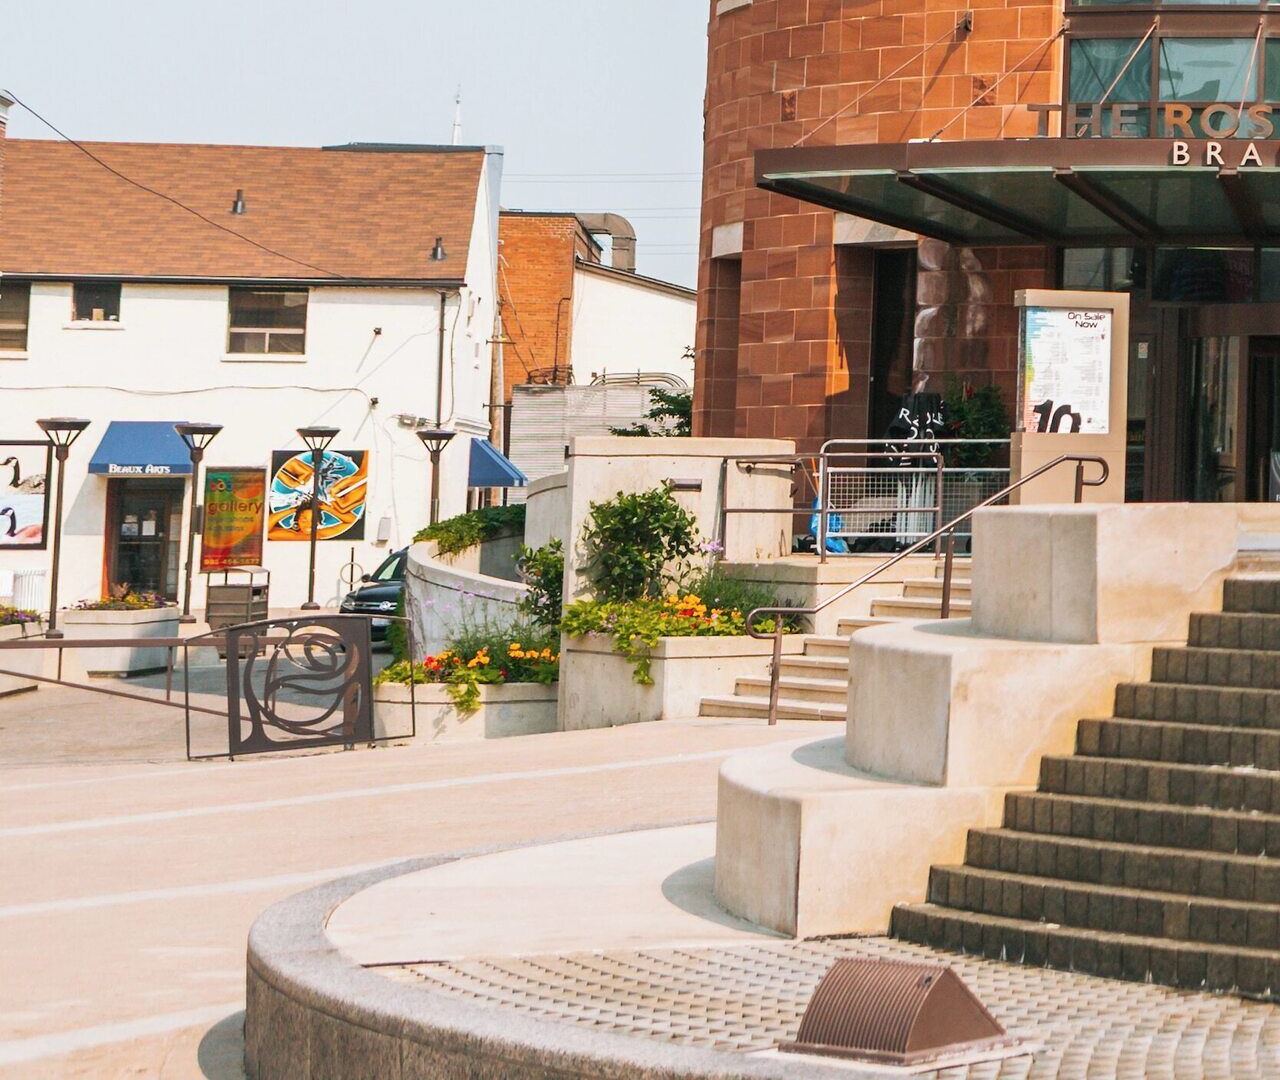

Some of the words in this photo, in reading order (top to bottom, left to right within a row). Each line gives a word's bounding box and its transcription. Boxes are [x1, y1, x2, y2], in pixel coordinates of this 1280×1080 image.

[1027, 104, 1139, 138] THE
[1068, 312, 1082, 320] On
[1084, 312, 1105, 321] Sale
[1075, 320, 1098, 328] Now
[108, 463, 143, 474] BEAUX
[145, 464, 171, 474] ARTS
[208, 500, 263, 515] gallery
